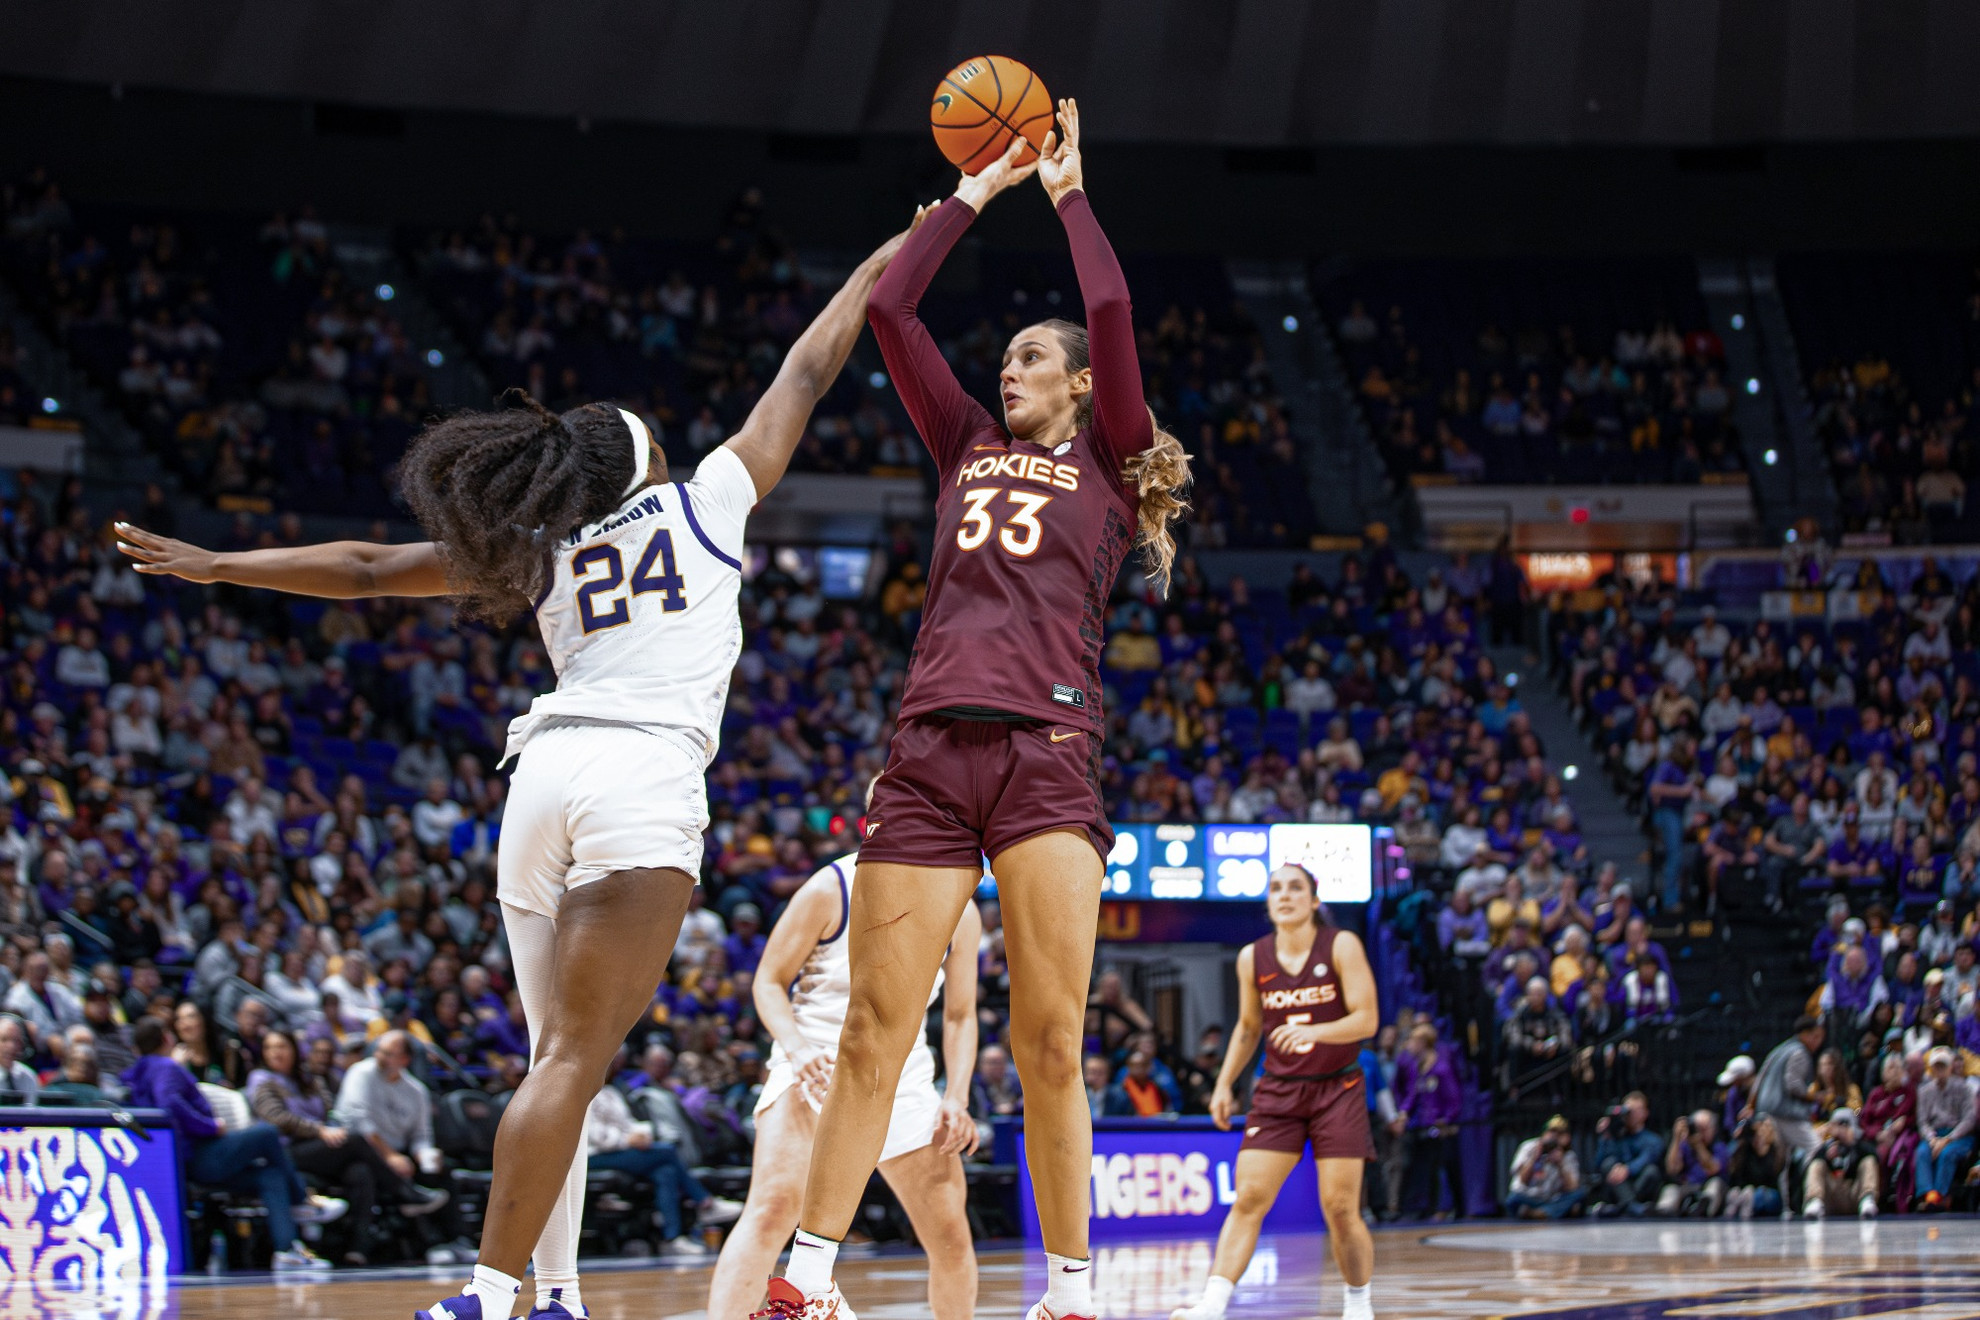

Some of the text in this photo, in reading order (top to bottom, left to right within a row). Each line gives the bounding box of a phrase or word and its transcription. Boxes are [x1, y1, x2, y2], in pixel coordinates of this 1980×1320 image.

[956, 453, 1080, 492] HOKIES
[956, 487, 1054, 558] 33
[570, 528, 688, 637] 24
[1261, 983, 1337, 1010] HOKIES
